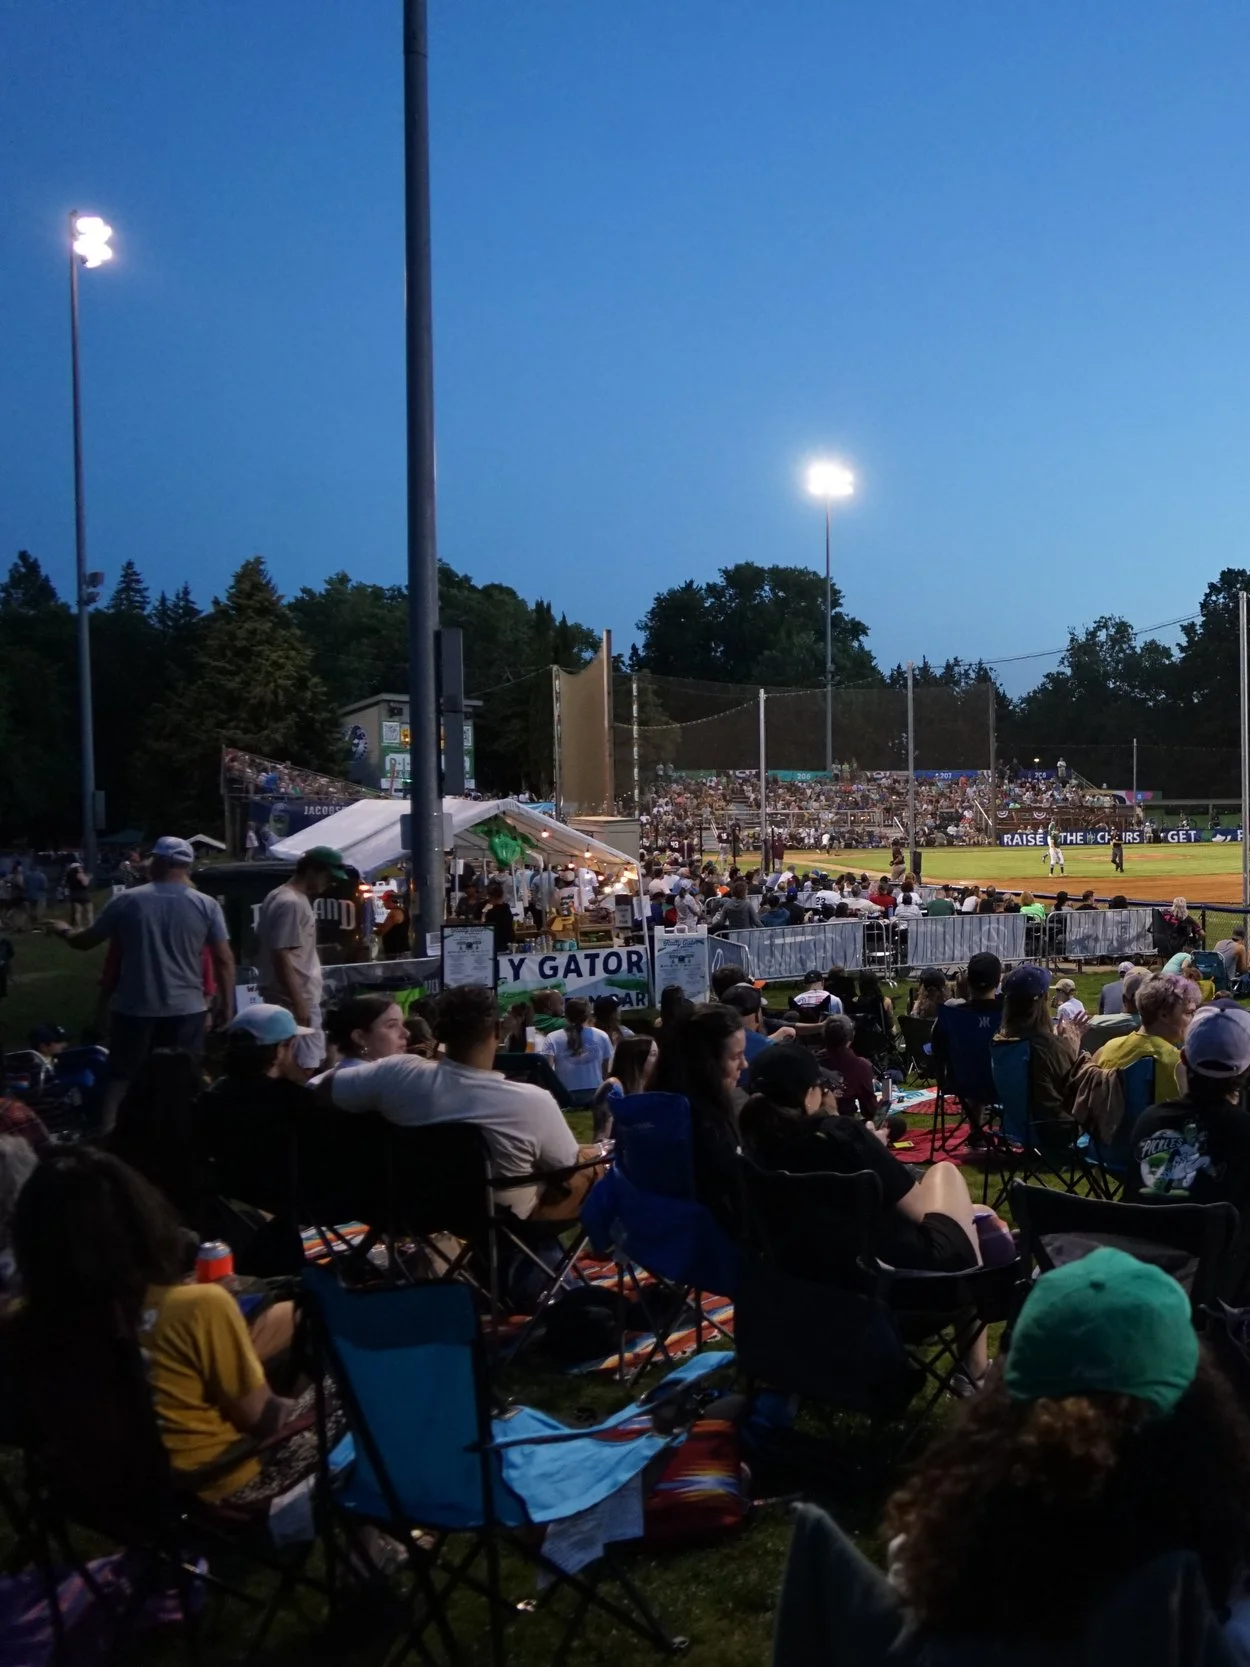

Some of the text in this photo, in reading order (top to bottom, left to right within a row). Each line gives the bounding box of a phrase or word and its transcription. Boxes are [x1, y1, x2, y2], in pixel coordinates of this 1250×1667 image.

[1003, 831, 1140, 846] RAISE THE CHIRS
[1167, 830, 1197, 843] GET
[538, 950, 644, 980] GATOR
[1141, 1138, 1184, 1158] PICKLES
